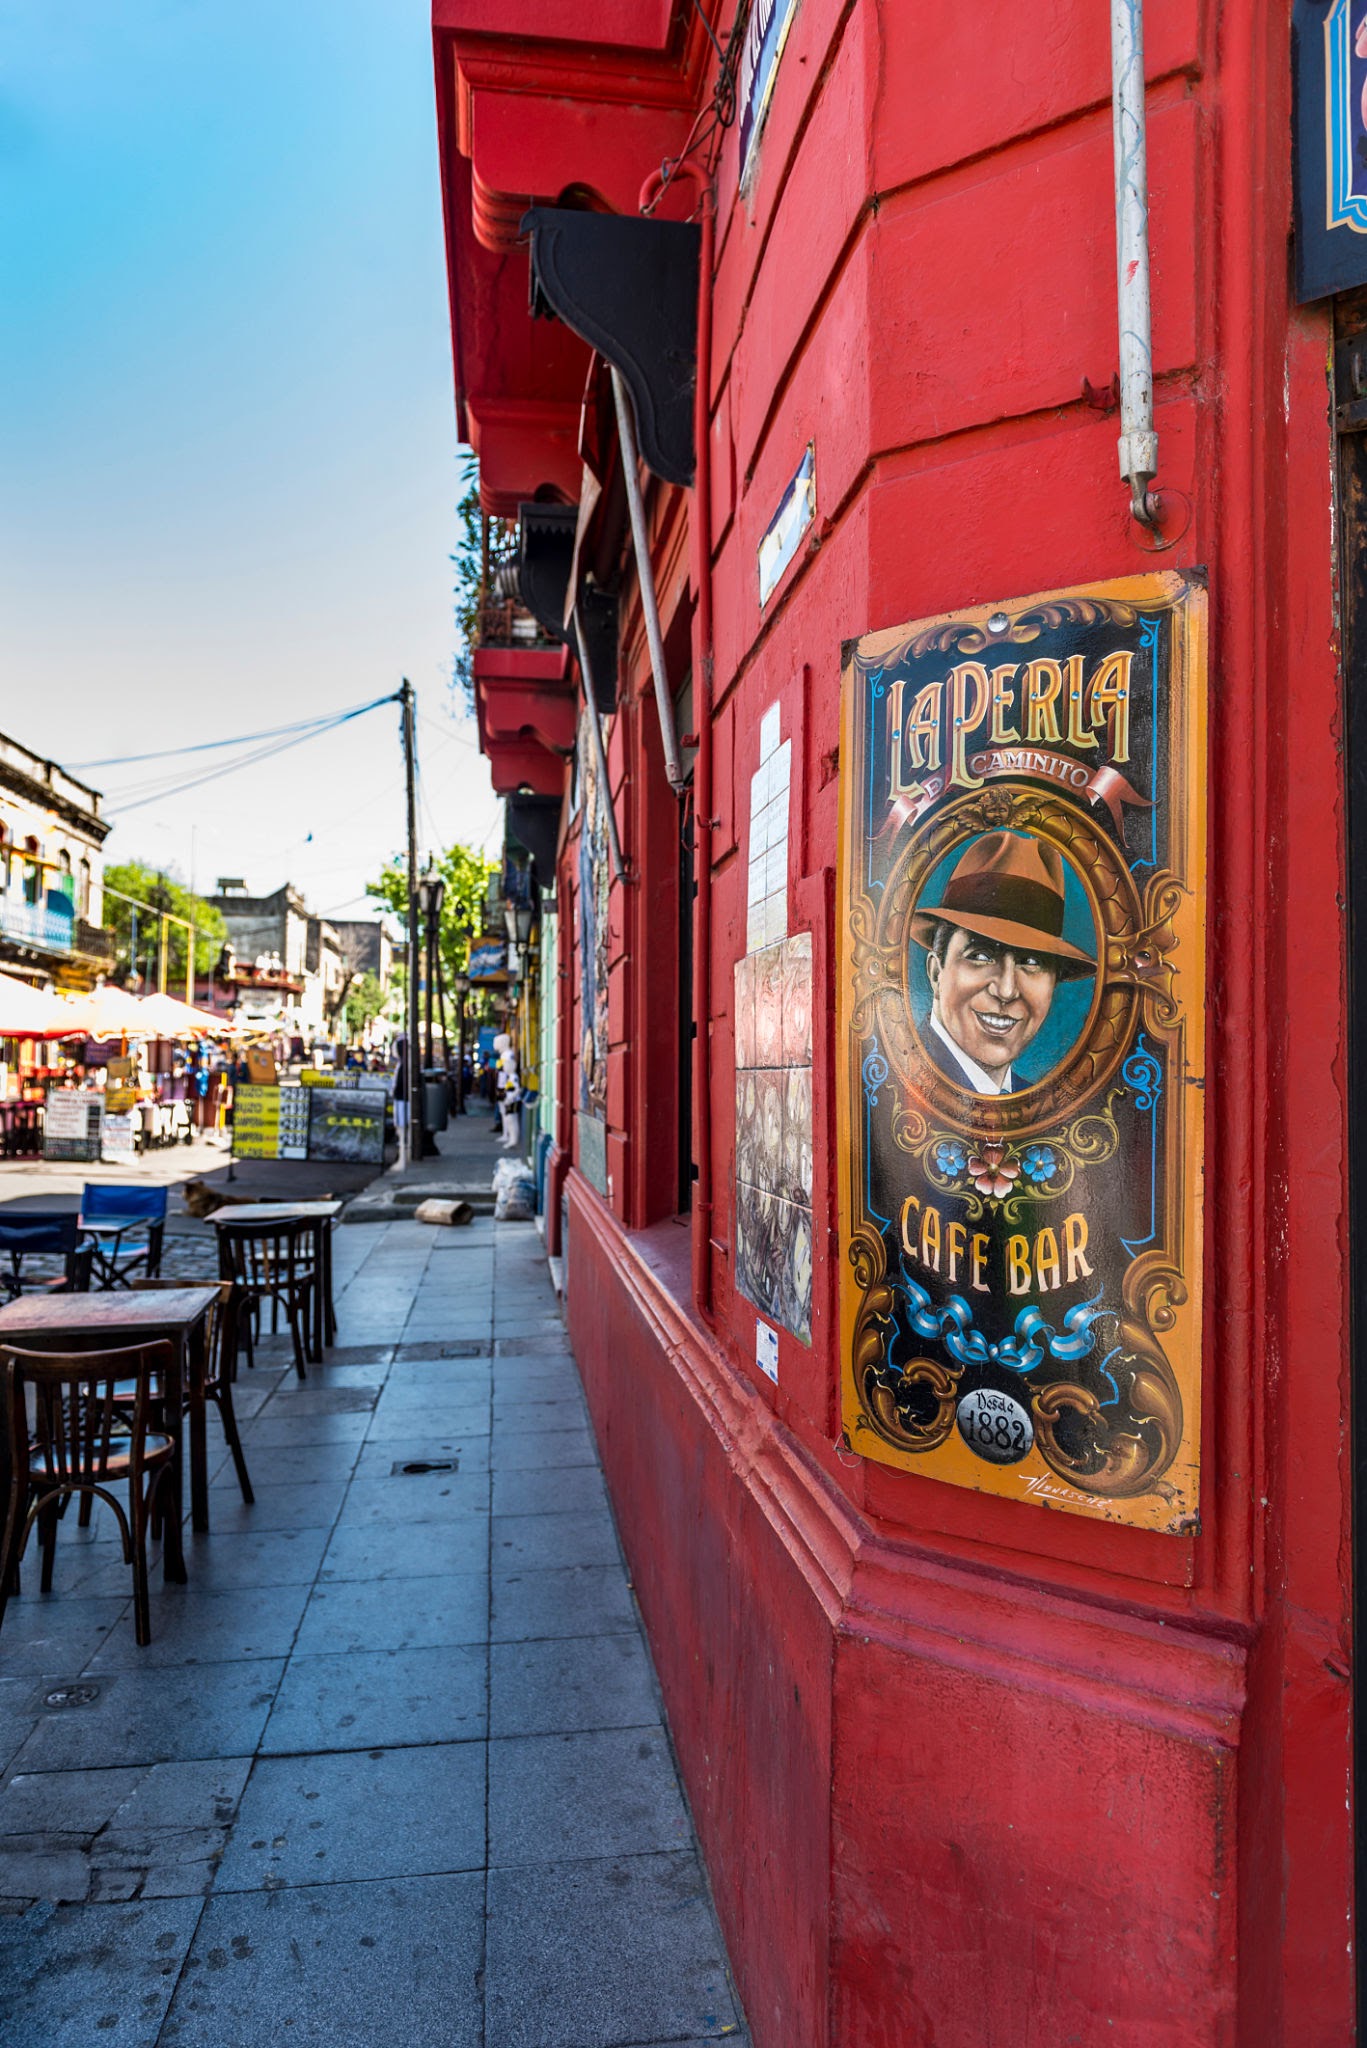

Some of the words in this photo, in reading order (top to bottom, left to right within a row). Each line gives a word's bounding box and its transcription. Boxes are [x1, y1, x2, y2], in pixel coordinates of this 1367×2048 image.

[887, 679, 944, 801] LA
[949, 650, 1135, 789] PERLA
[970, 751, 1089, 788] CAMINITO
[900, 1195, 991, 1294] CAFE
[1006, 1212, 1094, 1295] BAR
[976, 1391, 1014, 1415] Desde
[966, 1410, 1026, 1450] 1882
